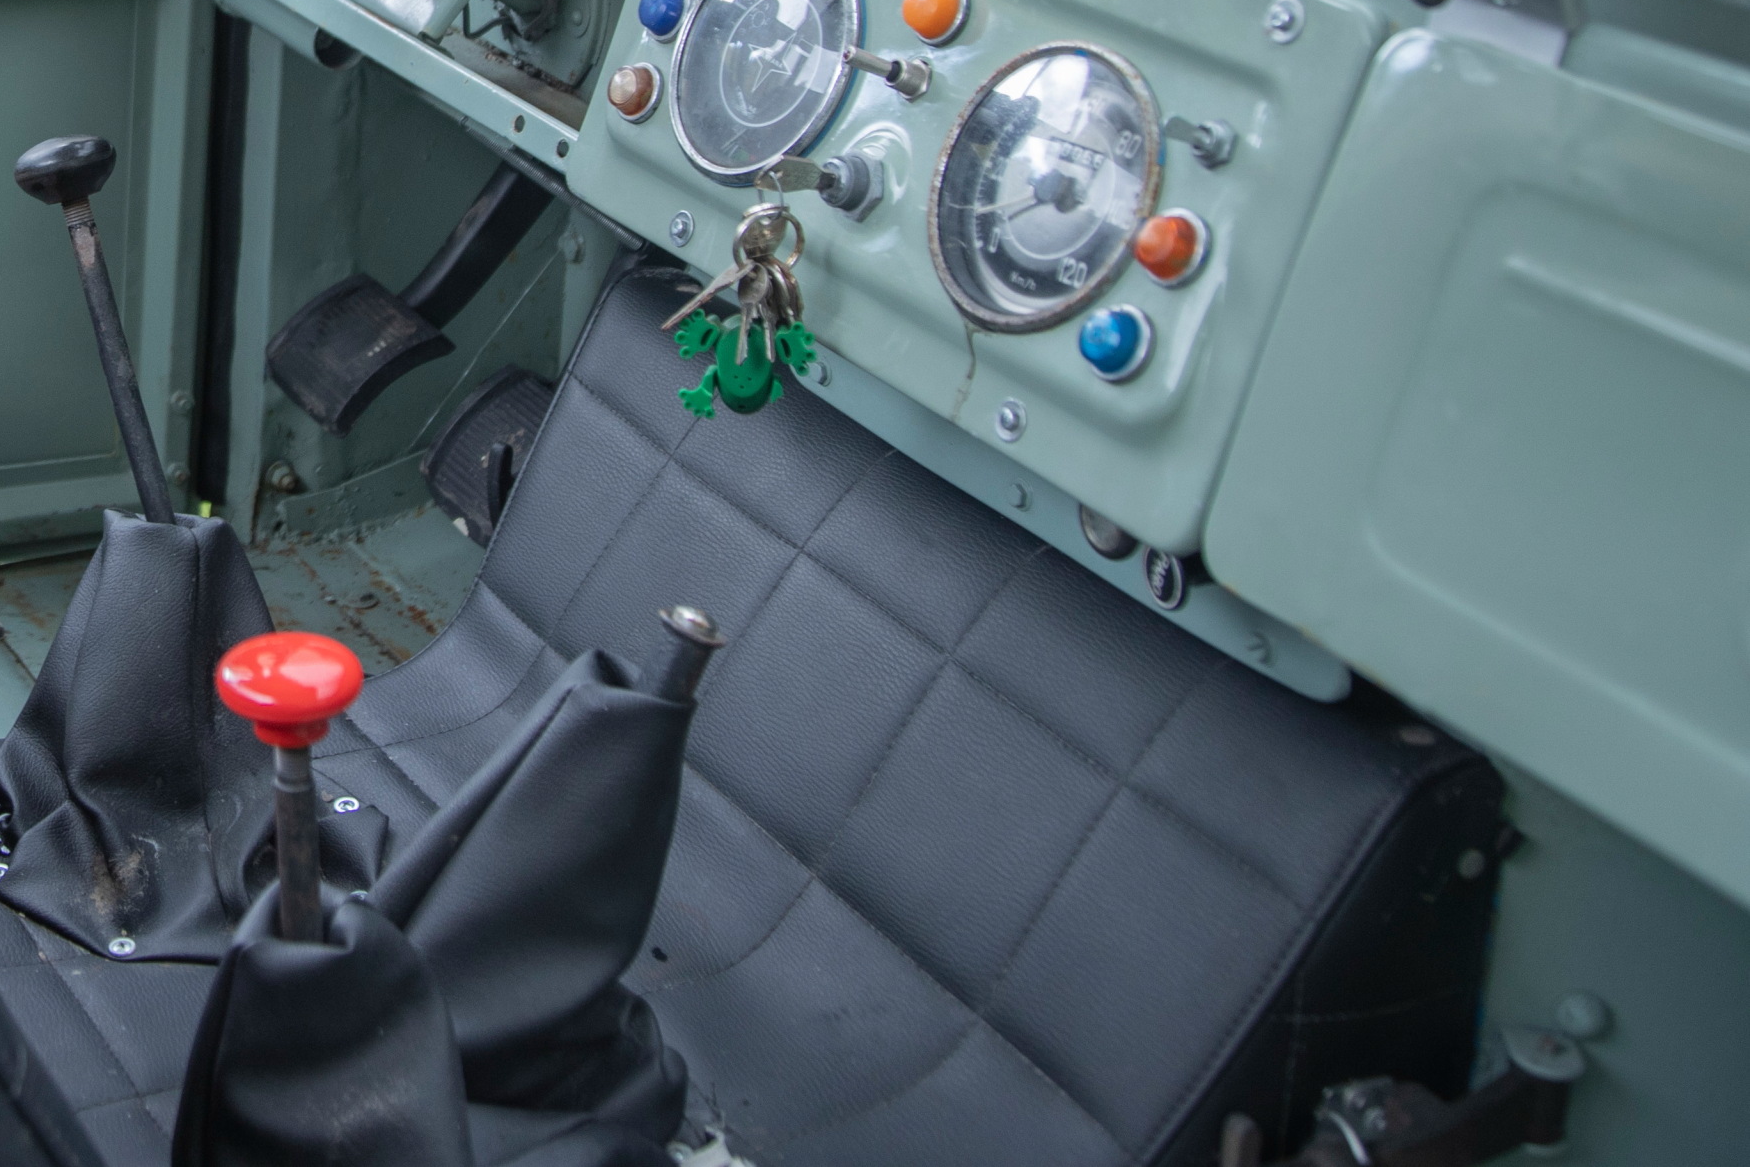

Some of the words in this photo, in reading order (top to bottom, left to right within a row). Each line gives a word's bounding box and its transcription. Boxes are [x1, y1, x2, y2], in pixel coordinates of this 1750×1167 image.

[1115, 130, 1143, 159] 80
[988, 227, 1001, 253] 0
[1058, 256, 1088, 289] 120
